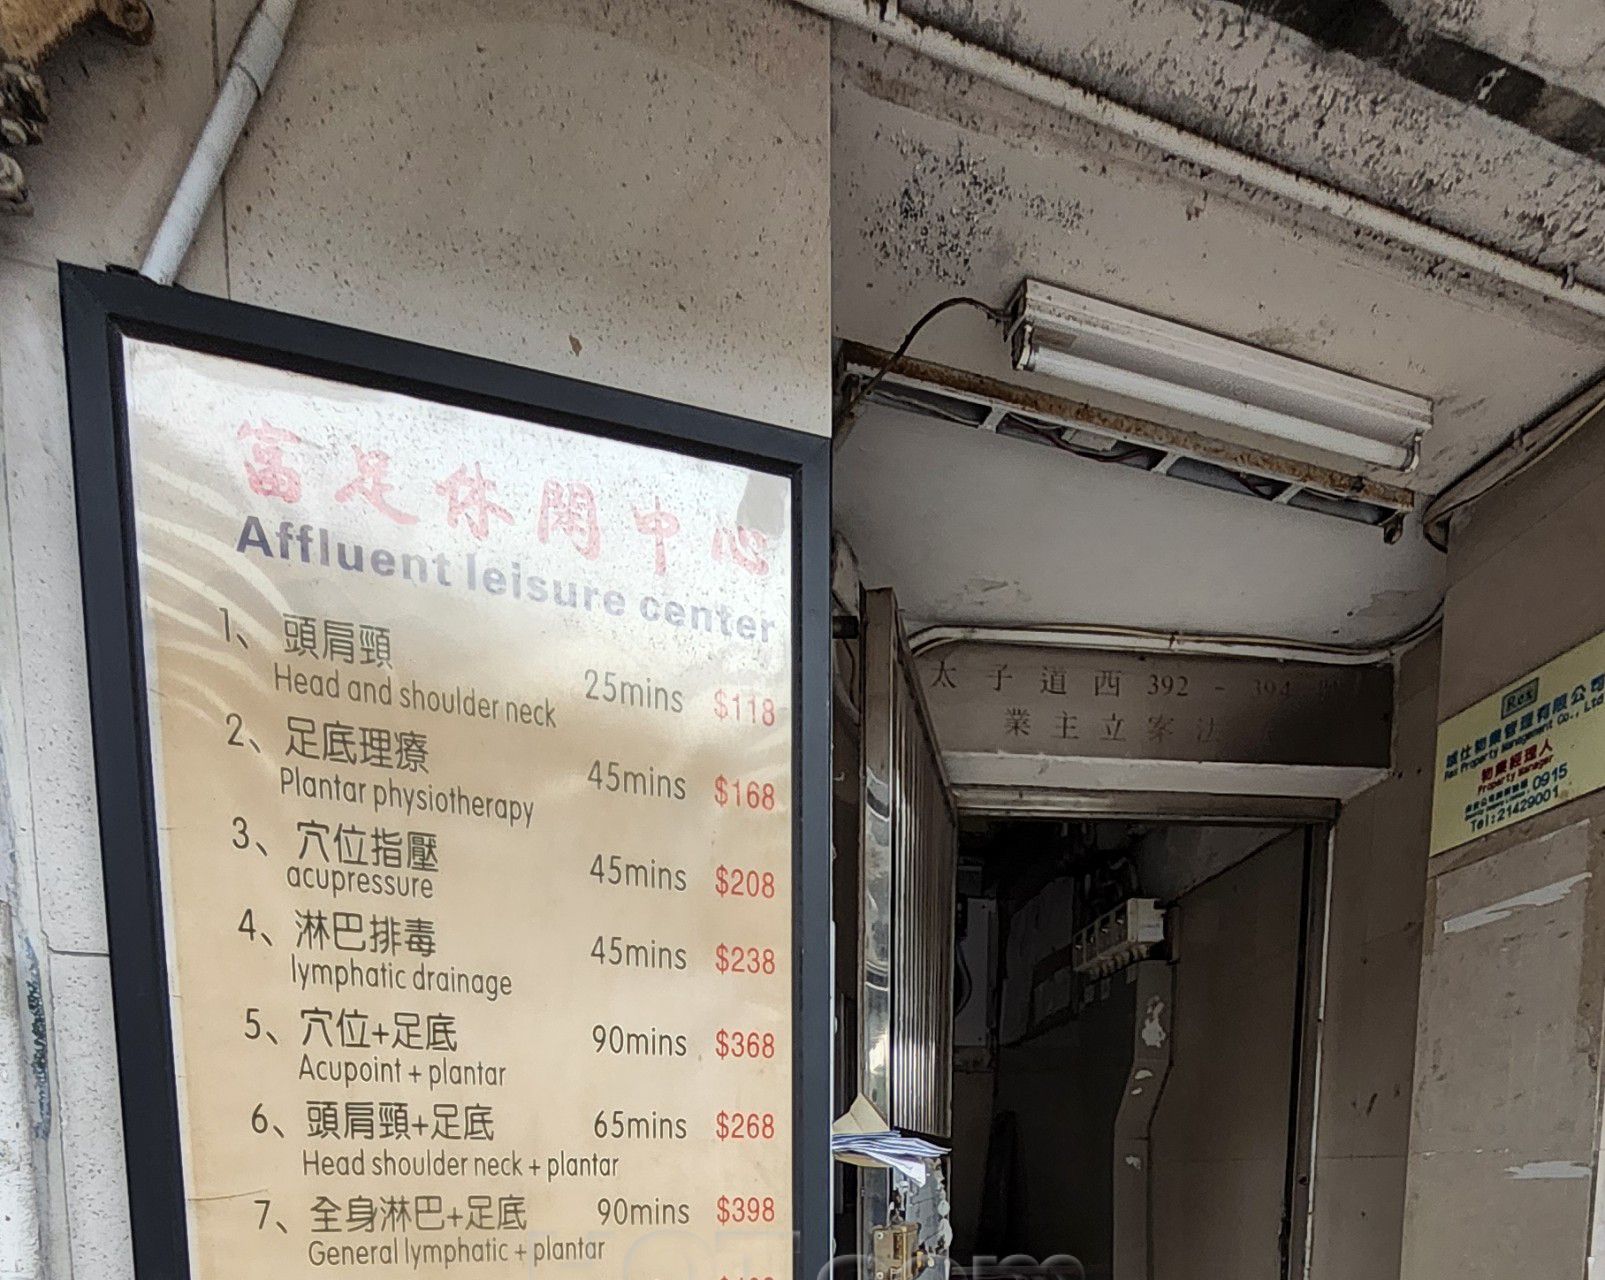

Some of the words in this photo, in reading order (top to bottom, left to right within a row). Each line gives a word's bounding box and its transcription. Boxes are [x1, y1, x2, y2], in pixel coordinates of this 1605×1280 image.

[237, 515, 451, 587] Affluent
[468, 562, 625, 617] leisure
[640, 595, 776, 643] center
[282, 613, 393, 670] 頭肩頸
[274, 663, 340, 699] Head
[347, 669, 392, 706] and
[400, 678, 498, 719] shoulder
[505, 699, 556, 728] neck
[584, 669, 684, 714] 25mins
[714, 688, 776, 728] $118
[930, 659, 1122, 698] 太子道西
[1147, 673, 1189, 697] 392
[284, 716, 429, 774] 足底理療
[587, 760, 687, 801] 45mins
[714, 775, 776, 811] $168
[1533, 762, 1568, 790] 0915
[281, 767, 366, 804] Plantar
[373, 774, 534, 829] physiotherapy
[296, 820, 439, 873] 穴位指壓
[286, 864, 434, 899] acupressure
[590, 854, 687, 893] 45mins
[714, 864, 776, 898] $208
[295, 910, 436, 958] 淋巴排毒
[291, 954, 406, 993] lymphatic
[413, 964, 513, 1000] drainage
[590, 936, 687, 972] 45mins
[714, 944, 776, 976] $238
[300, 1007, 457, 1053] 穴位+足底
[591, 1024, 687, 1058] 90mins
[714, 1028, 776, 1060] $368
[299, 1054, 401, 1090] Acupoint
[408, 1067, 421, 1083] +
[429, 1057, 507, 1091] plantar
[306, 1100, 495, 1142] 頭肩頸+足底
[593, 1109, 687, 1142] 65mins
[714, 1110, 776, 1142] $268
[302, 1149, 365, 1177] Head
[372, 1150, 468, 1177] shoulder
[474, 1151, 524, 1177] neck
[528, 1161, 541, 1176] +
[547, 1151, 619, 1183] plantar
[309, 1192, 528, 1234] 全身淋巴+足底
[597, 1197, 690, 1227] 90mins
[716, 1195, 776, 1224] $398
[308, 1239, 398, 1267] General
[404, 1236, 508, 1270] lymphatic
[515, 1246, 527, 1261] +
[533, 1235, 606, 1267] plantar
